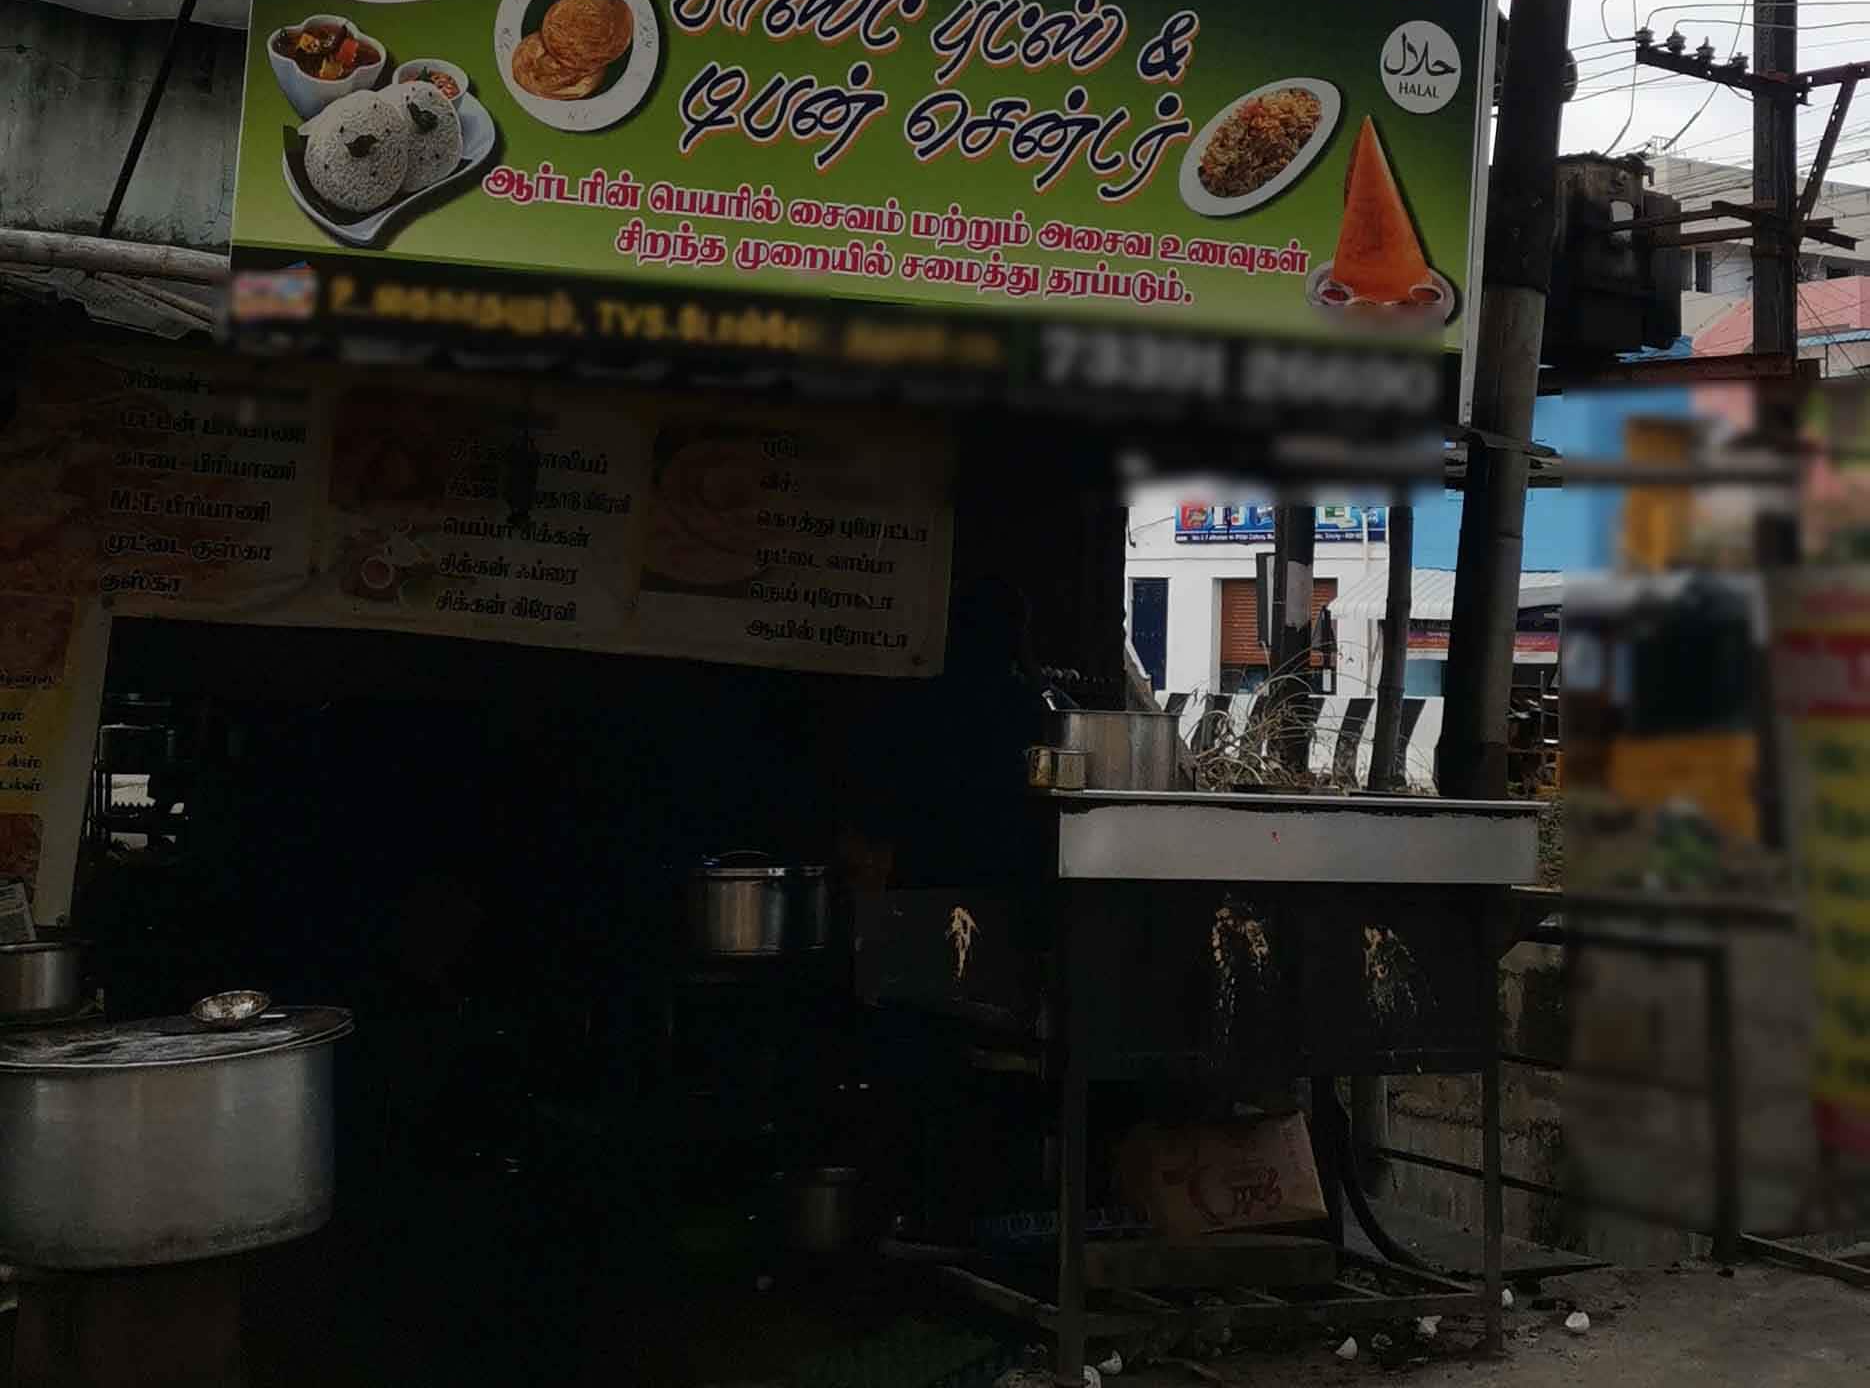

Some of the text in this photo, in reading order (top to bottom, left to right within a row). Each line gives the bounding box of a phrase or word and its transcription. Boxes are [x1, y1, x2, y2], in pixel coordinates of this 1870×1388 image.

[1137, 11, 1199, 80] &
[680, 62, 1191, 200] டிபன் சென்டர்
[1399, 81, 1441, 99] HALAL
[482, 161, 1311, 276] ஆர்டரின் பெயரில் சைவம் மற்றும் அசைவ உணவுகள்
[615, 218, 1194, 304] சிறந்த முறையில் சமைத்து தரப்படும்.
